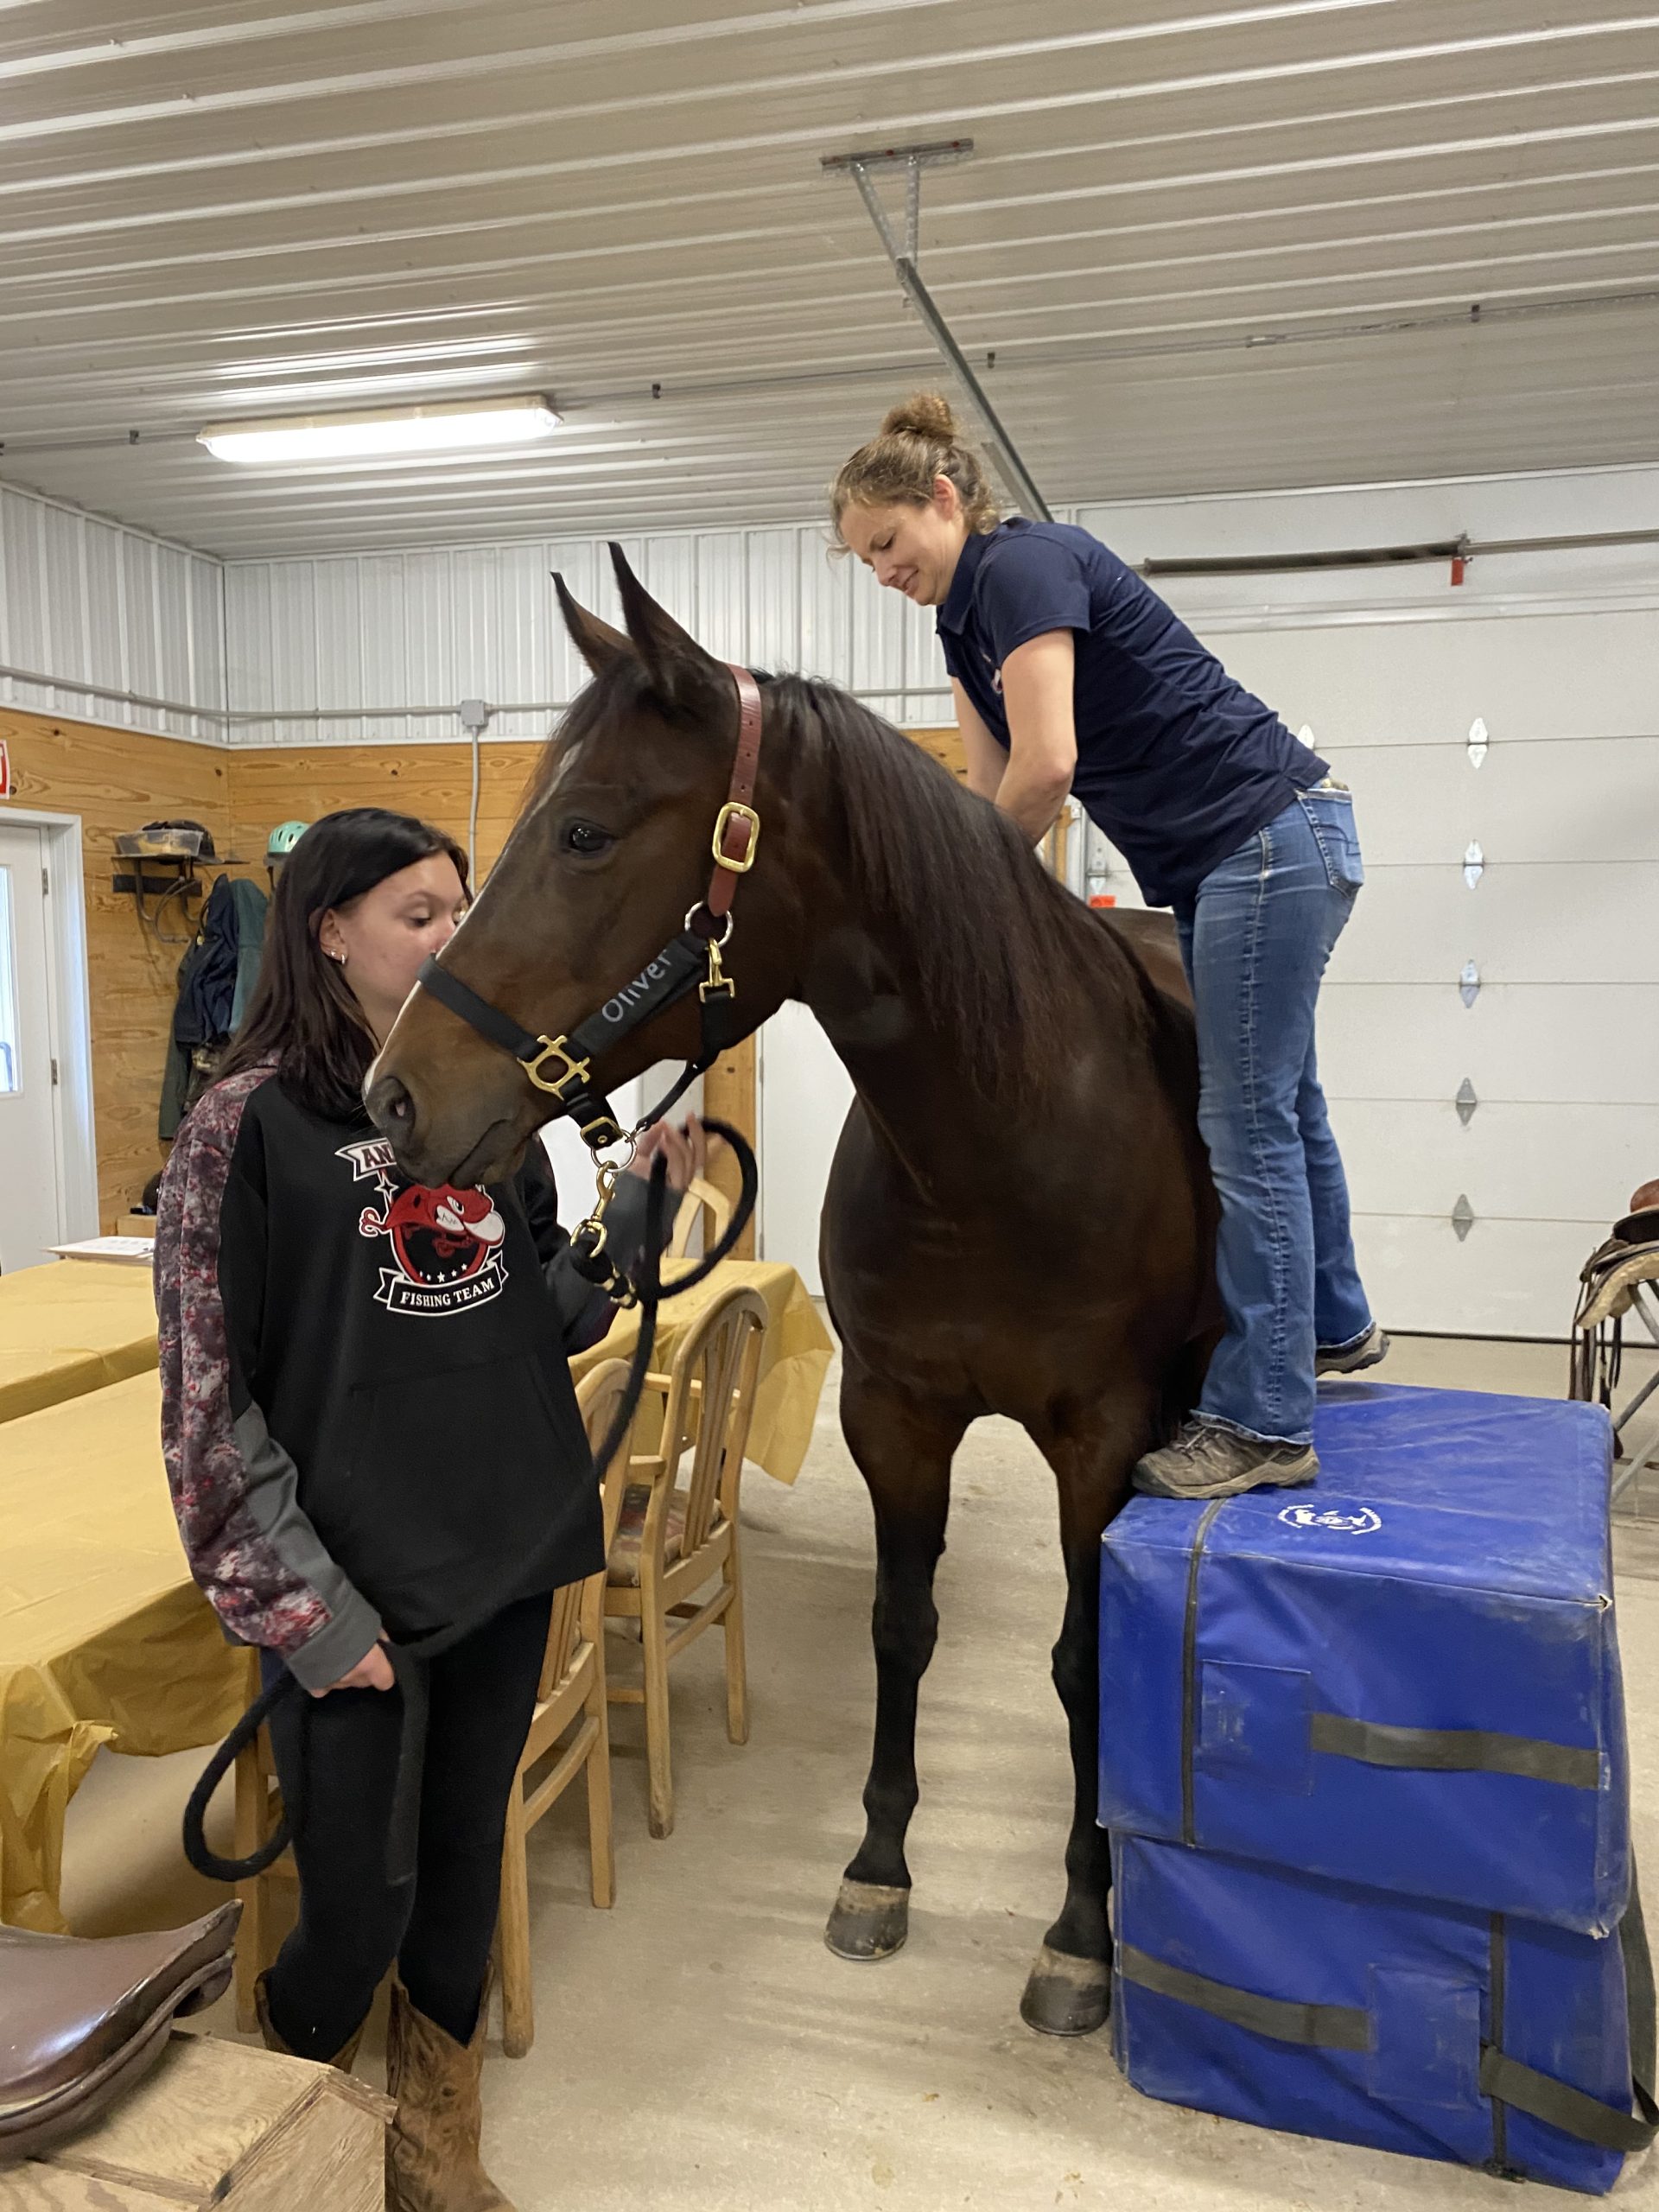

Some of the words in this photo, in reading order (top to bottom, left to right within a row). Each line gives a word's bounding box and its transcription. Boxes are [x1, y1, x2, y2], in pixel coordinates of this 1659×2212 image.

[601, 949, 671, 1022] Oliver
[361, 1144, 395, 1168] AN
[400, 1291, 451, 1307] FISHING
[454, 1277, 495, 1303] TEAM
